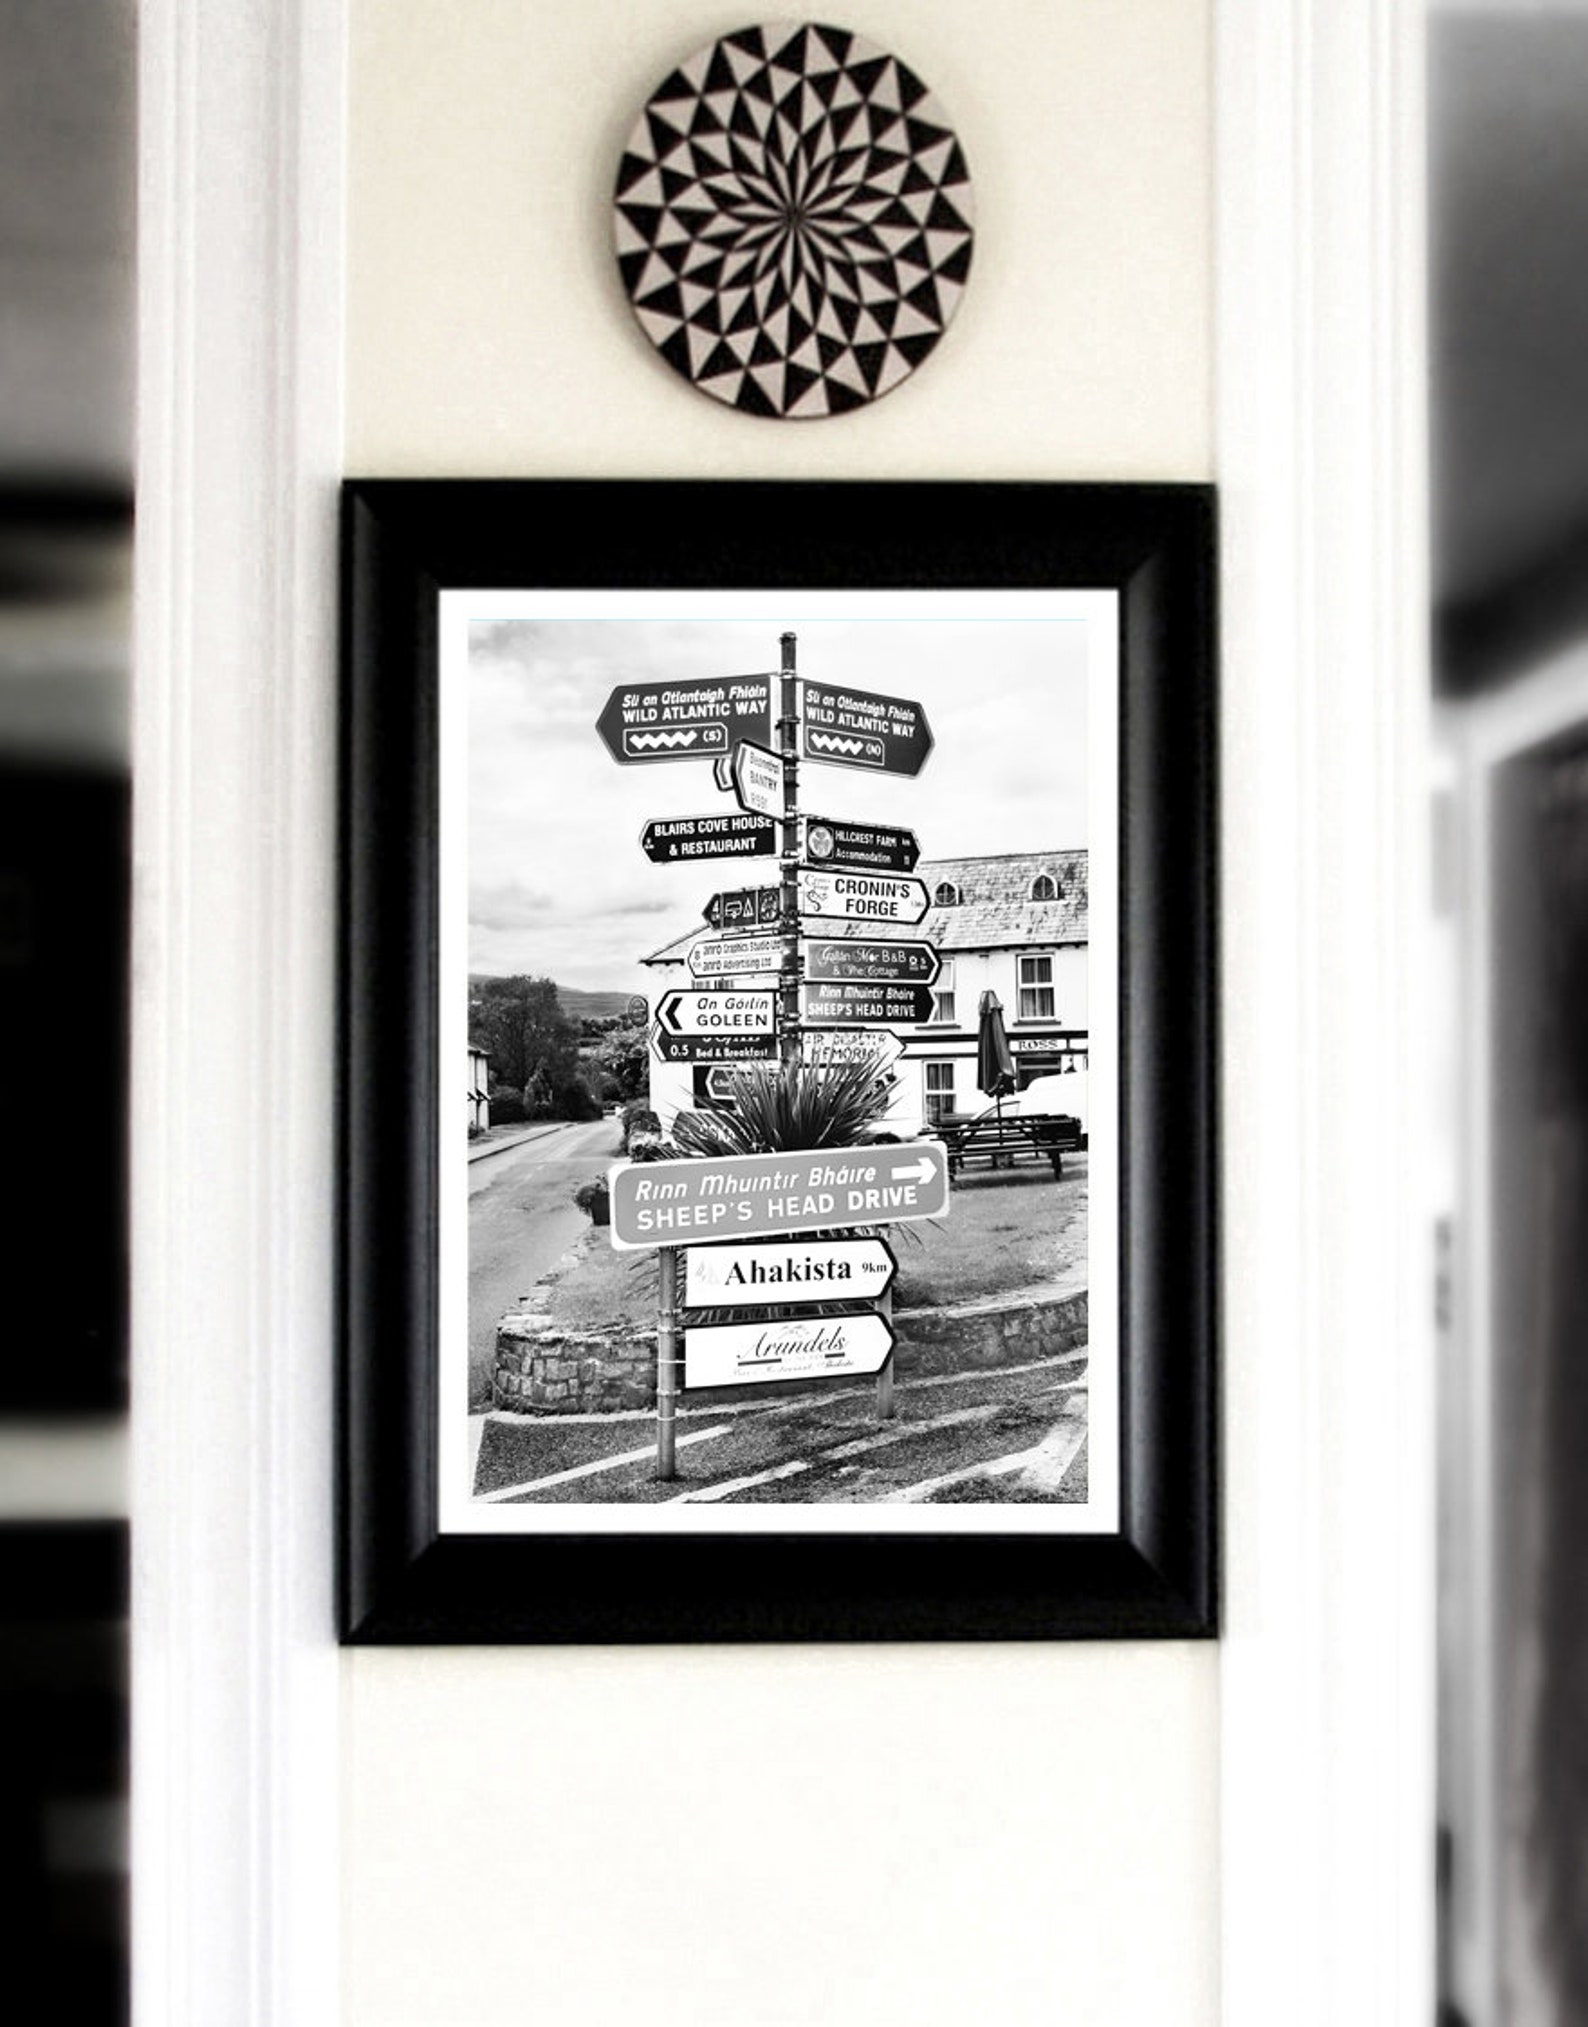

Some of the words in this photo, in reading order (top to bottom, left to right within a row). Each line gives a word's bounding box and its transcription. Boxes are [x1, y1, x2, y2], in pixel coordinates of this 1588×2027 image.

[643, 698, 658, 707] an
[822, 696, 835, 706] an
[622, 708, 658, 723] WILD
[662, 703, 731, 721] ATLANTIC
[735, 700, 767, 716] WAY
[806, 706, 835, 723] WILD
[838, 713, 889, 734] ATLANTIC
[892, 722, 916, 738] WAY
[702, 729, 722, 743] (S)
[654, 821, 696, 837] BLAIRS
[698, 818, 729, 833] COVE
[732, 815, 773, 831] HOUSE
[669, 843, 678, 856] &
[681, 837, 757, 855] RESTAURANT
[835, 829, 874, 844] HILLCREST
[876, 835, 898, 847] FARM
[835, 878, 911, 899] CRONIN'S
[846, 898, 899, 917] FORGE
[881, 949, 907, 963] B&B
[807, 1002, 853, 1017] SHEEP'S
[855, 1003, 884, 1017] HEAD
[886, 1004, 916, 1018] DRIVE
[696, 1013, 768, 1027] GOLEEN
[670, 1044, 689, 1057] 0.5
[696, 1047, 713, 1058] Bed
[715, 1048, 722, 1058] &
[723, 1047, 768, 1058] Breakfast
[1018, 1039, 1058, 1050] ROSS
[635, 1180, 688, 1201] Rinn
[700, 1171, 799, 1197] Mhuintir
[808, 1165, 876, 1187] Bháire
[637, 1201, 753, 1230] SHEEP'S
[767, 1193, 834, 1218] HEAD
[848, 1185, 917, 1211] DRIVE
[724, 1256, 852, 1286] Ahakista
[862, 1262, 888, 1274] 9km
[736, 1326, 847, 1359] Arundels
